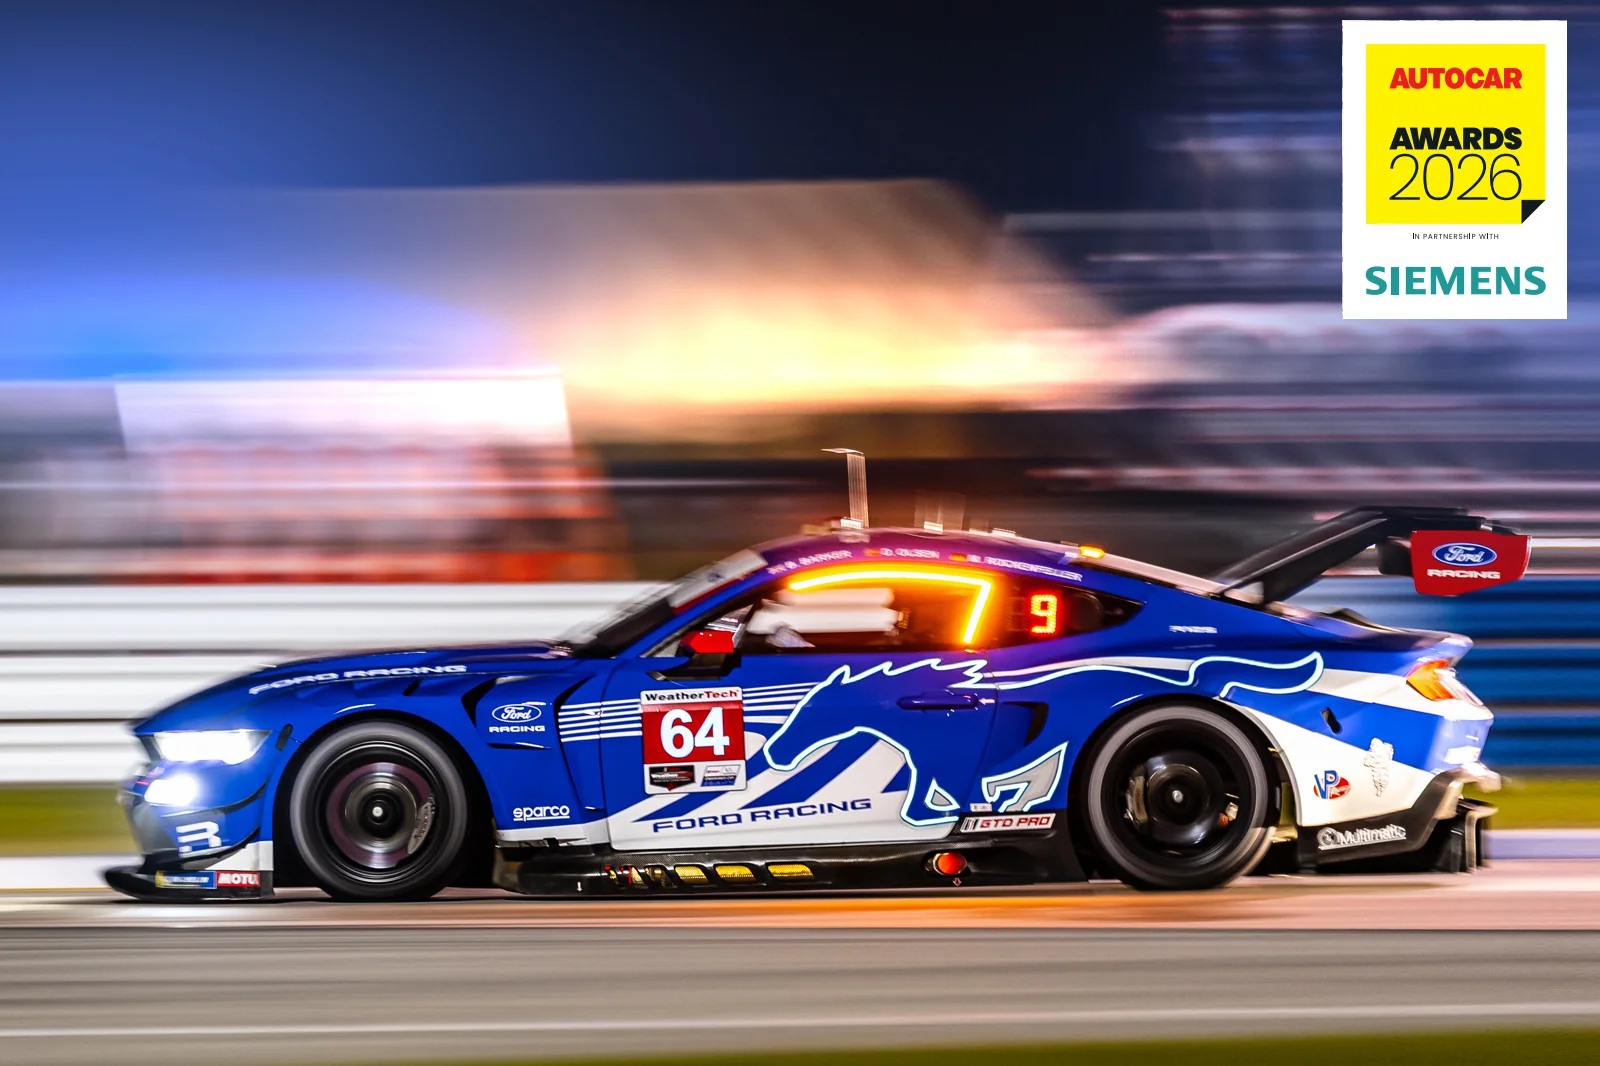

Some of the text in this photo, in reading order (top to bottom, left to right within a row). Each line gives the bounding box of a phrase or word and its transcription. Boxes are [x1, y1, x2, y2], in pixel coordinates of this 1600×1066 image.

[1443, 545, 1485, 563] Ford
[1426, 568, 1501, 580] RACING
[1030, 594, 1058, 634] 9
[249, 665, 467, 695] FORD RACING
[644, 690, 738, 702] WeatherTech
[501, 706, 532, 720] Ford
[488, 725, 546, 733] RACING
[660, 706, 730, 759] 64
[1313, 769, 1340, 800] VP
[513, 804, 571, 821] sparco
[653, 798, 873, 833] FORD RACING
[980, 816, 1051, 829] GTD PRO
[1336, 823, 1407, 846] Multimatic
